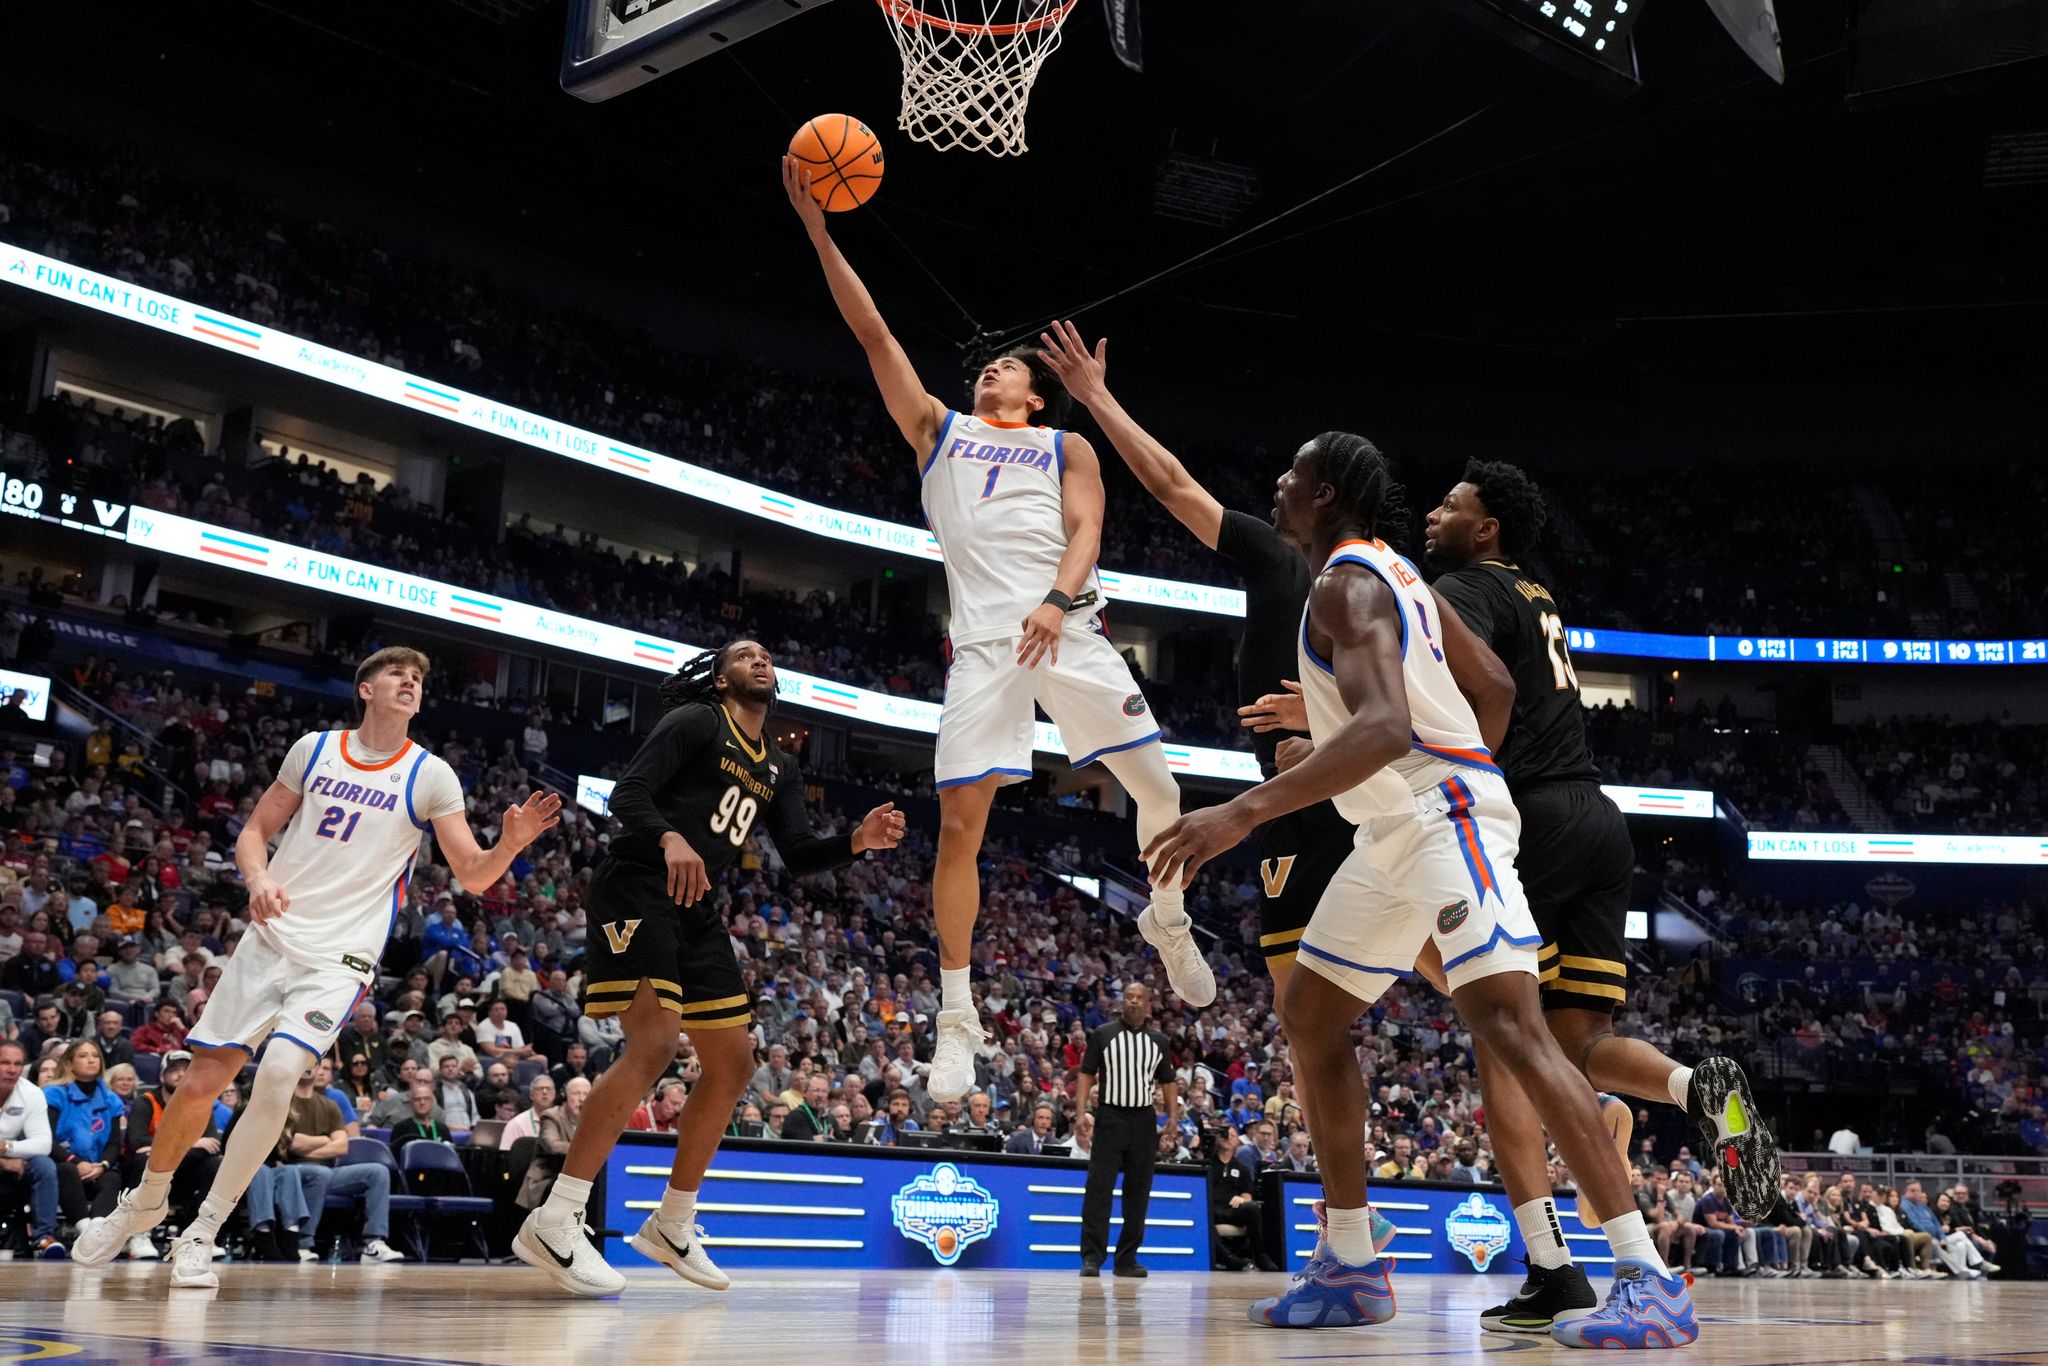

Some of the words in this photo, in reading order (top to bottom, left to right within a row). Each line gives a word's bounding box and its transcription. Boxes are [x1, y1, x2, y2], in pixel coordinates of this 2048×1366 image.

[36, 264, 73, 290] FUN
[78, 278, 132, 308] CAN'T
[137, 297, 181, 324] LOSE
[490, 409, 518, 431] FUN
[565, 434, 598, 457] LOSE
[948, 438, 1053, 473] FLORIDA
[4, 478, 43, 509] 80
[980, 465, 1001, 498] 1
[819, 513, 843, 531] FUN
[887, 530, 917, 548] LOSE
[307, 559, 341, 583] FUN
[346, 568, 394, 596] CAN'T
[399, 583, 438, 607] LOSE
[1146, 584, 1171, 599] FUN
[1212, 593, 1240, 610] LOSE
[1816, 641, 1826, 657] 1
[1883, 642, 1898, 659] 9
[1947, 643, 1971, 660] 10
[2022, 642, 2046, 659] 21
[308, 775, 399, 813] FLORIDA
[720, 756, 775, 803] VANDERBILT
[315, 805, 363, 843] 21
[709, 784, 758, 847] 99
[1824, 840, 1856, 854] LOSE
[896, 1200, 995, 1223] TOURNAMENT
